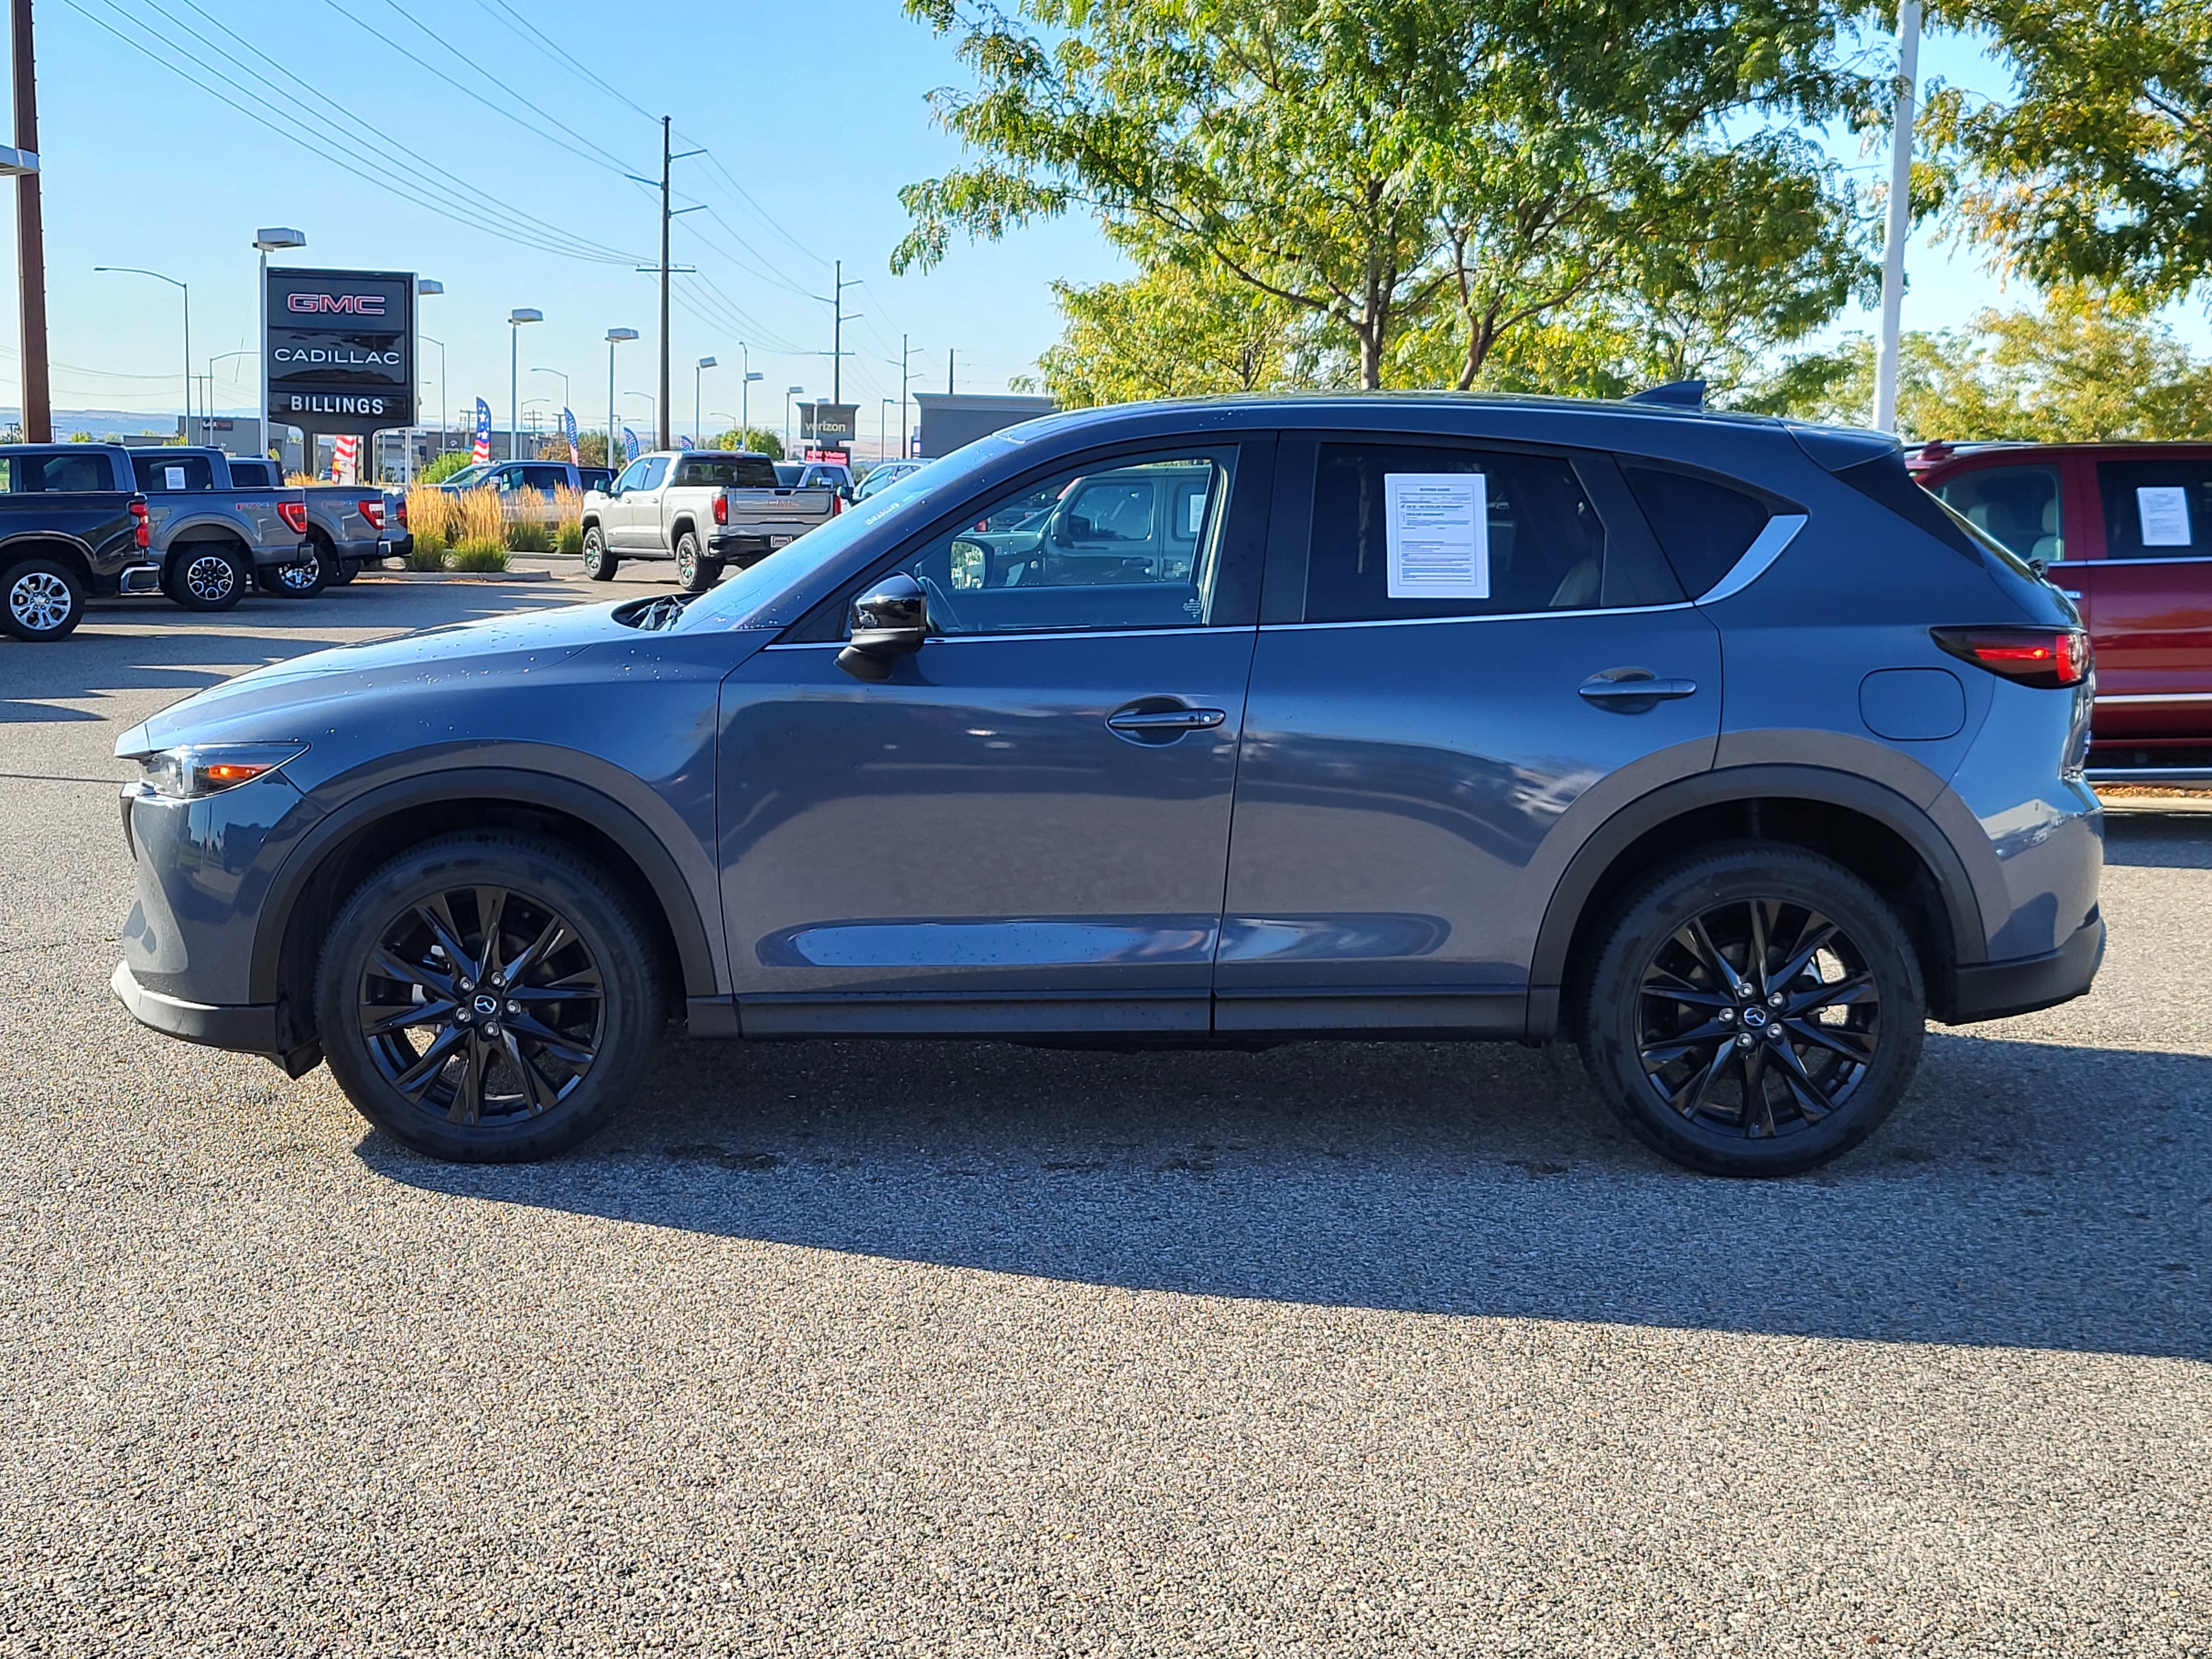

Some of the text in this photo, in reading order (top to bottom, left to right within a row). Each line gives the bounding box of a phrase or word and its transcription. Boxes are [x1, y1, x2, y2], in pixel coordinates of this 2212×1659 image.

[288, 293, 385, 315] GMC
[274, 349, 400, 365] CADILLAC
[291, 395, 384, 415] BILLINGS
